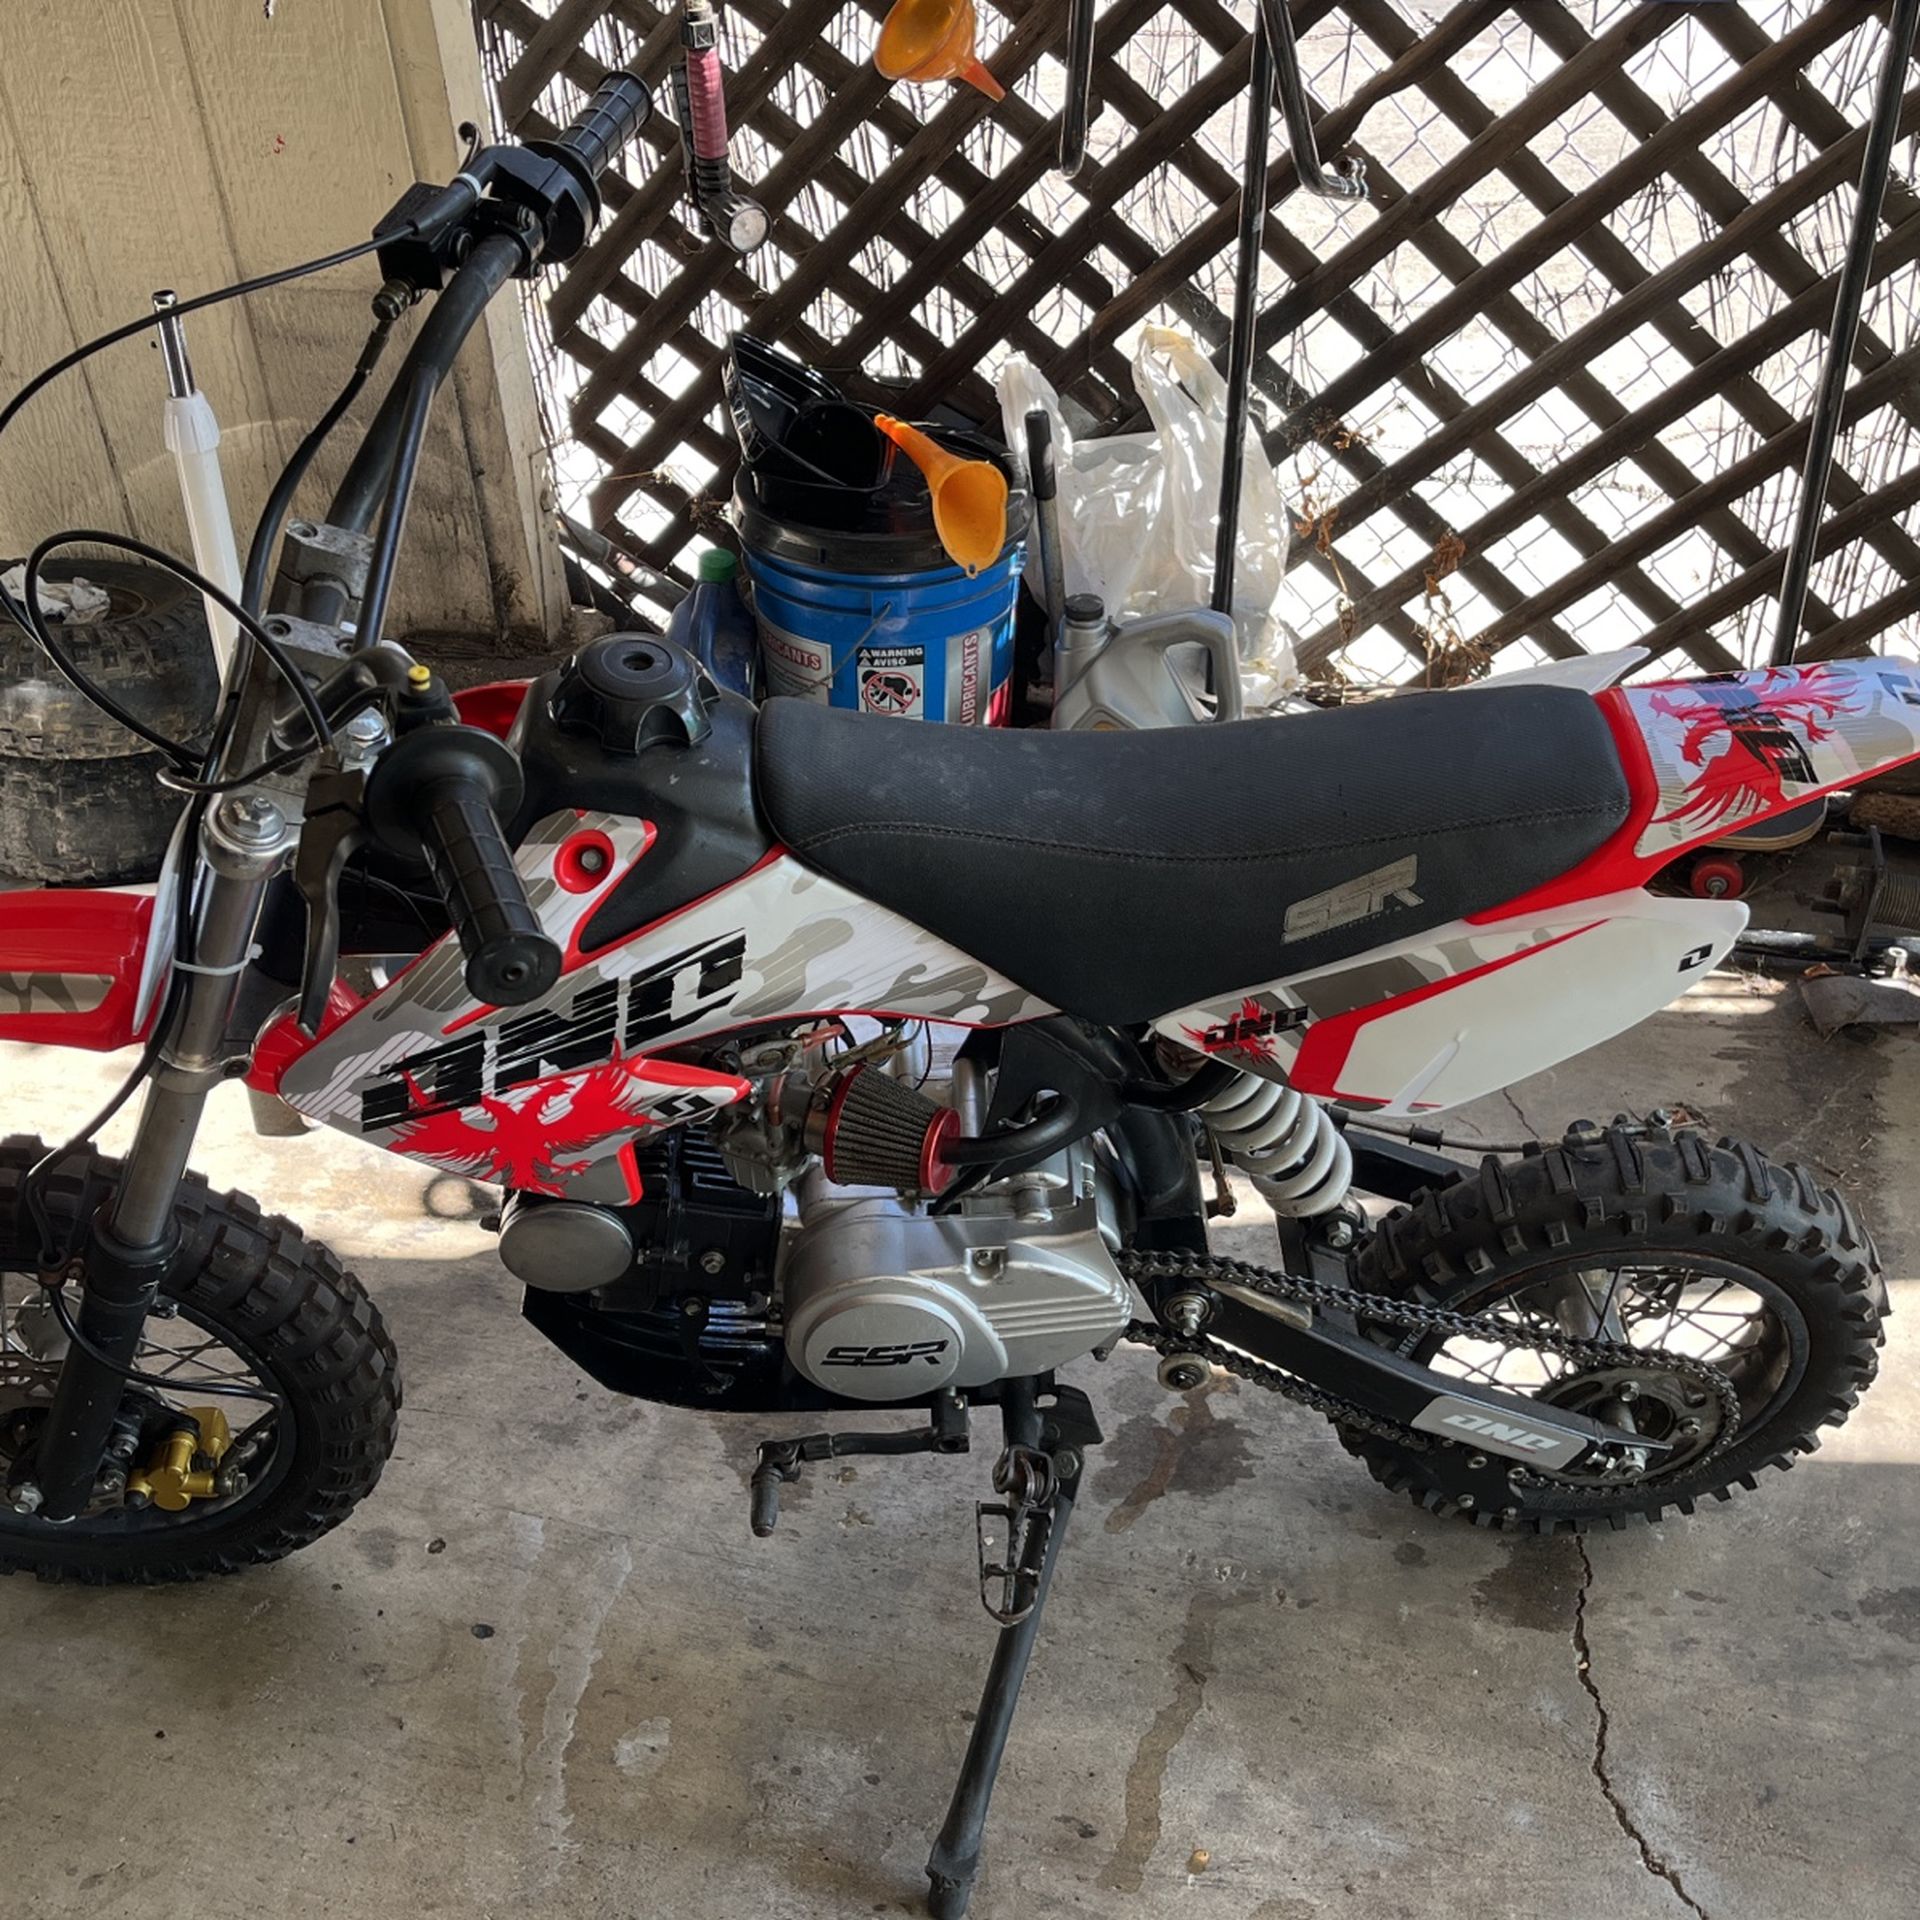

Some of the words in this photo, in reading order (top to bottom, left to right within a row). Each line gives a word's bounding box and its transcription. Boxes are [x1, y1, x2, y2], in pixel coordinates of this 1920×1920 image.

[871, 647, 924, 658] WARNING
[873, 657, 907, 667] AVISO
[961, 631, 979, 726] LUBRICANTS
[820, 1339, 949, 1367] SSR
